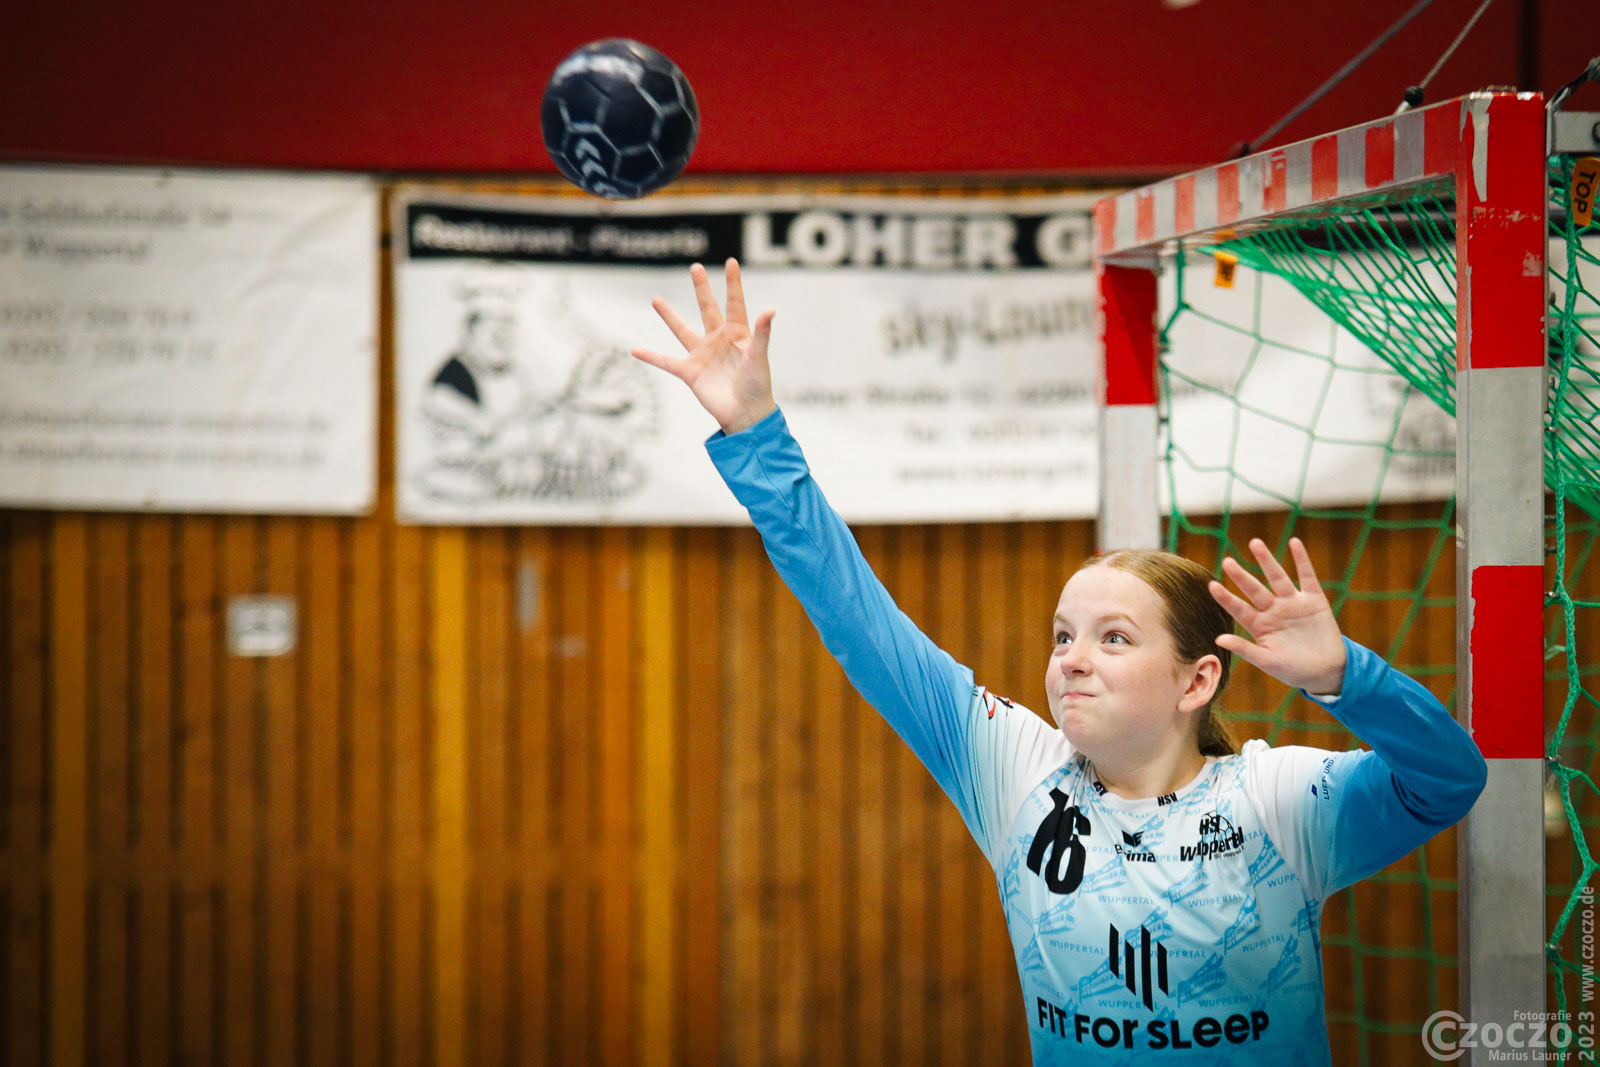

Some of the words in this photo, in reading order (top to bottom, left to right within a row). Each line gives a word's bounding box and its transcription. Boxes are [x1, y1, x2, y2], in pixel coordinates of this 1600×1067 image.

[1574, 171, 1596, 213] TOP
[743, 210, 1018, 268] LOHER
[1157, 792, 1178, 807] HSV
[1026, 786, 1092, 895] 16
[1098, 895, 1153, 906] WUPPERTAL
[1188, 892, 1244, 909] WUPPERTAL
[1049, 938, 1105, 956] WUPPERTAL
[1241, 933, 1286, 953] WUPPERTAL
[1037, 996, 1067, 1039] FIT
